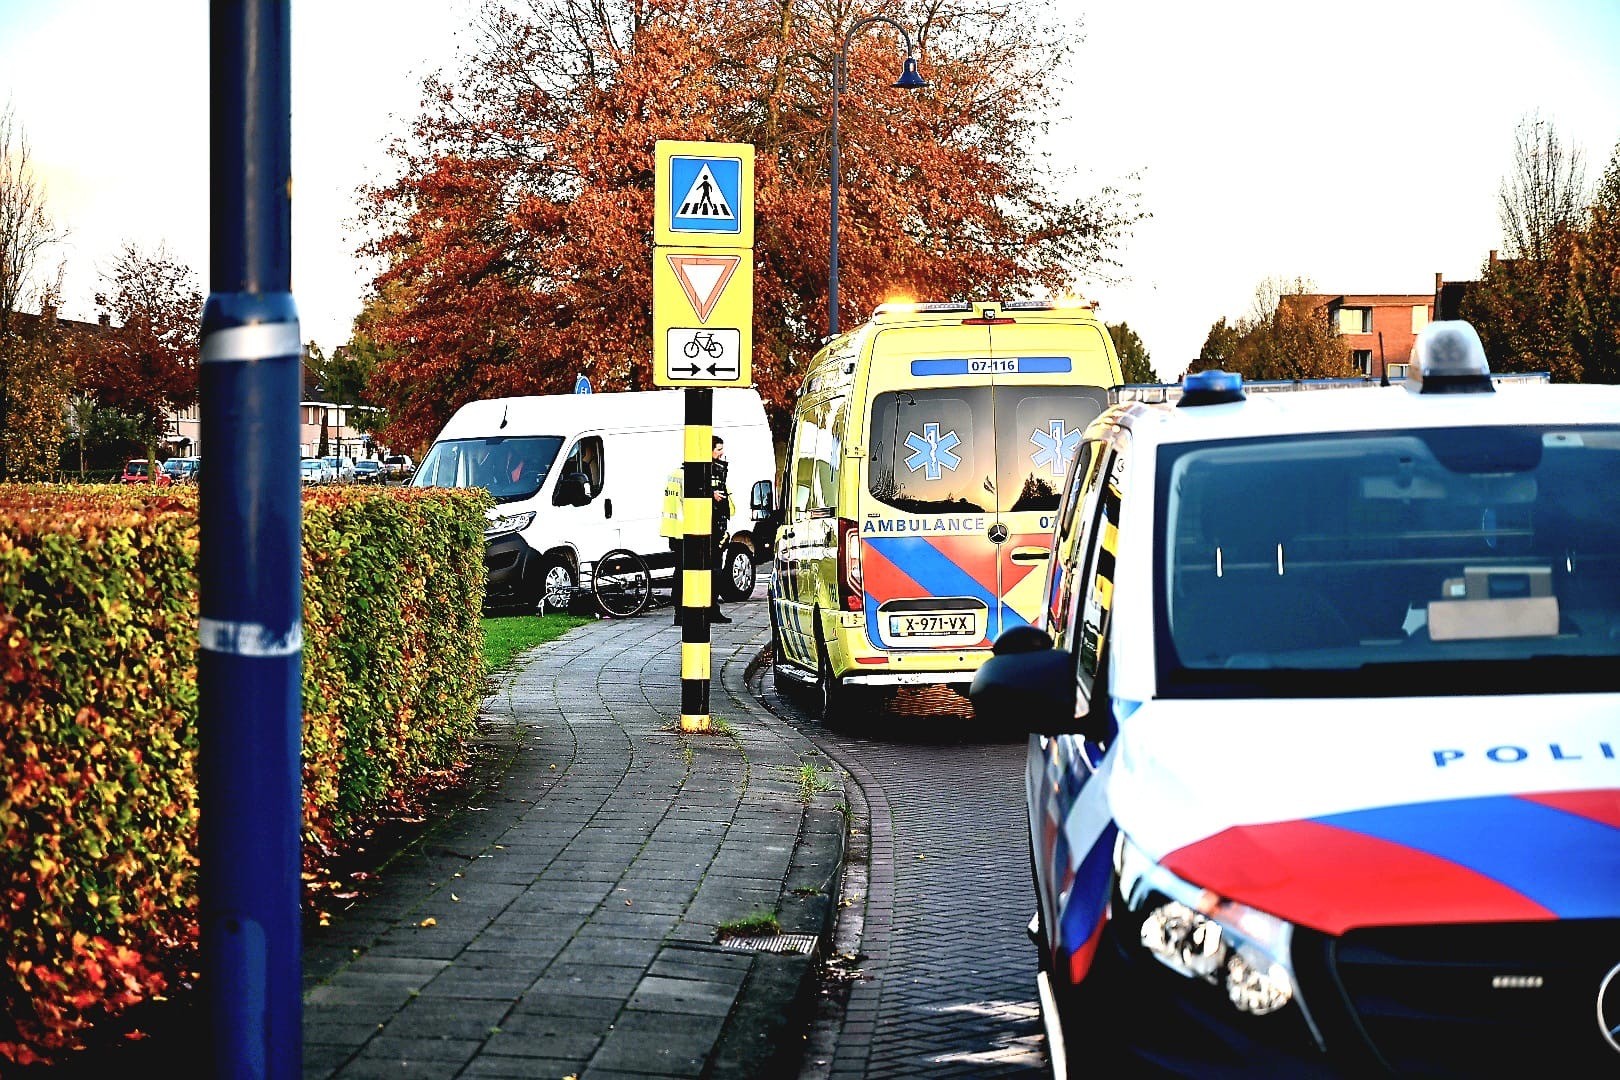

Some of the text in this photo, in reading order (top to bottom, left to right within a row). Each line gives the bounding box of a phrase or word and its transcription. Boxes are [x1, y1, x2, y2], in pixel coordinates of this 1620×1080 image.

[971, 360, 1015, 371] 07-116
[863, 517, 985, 533] AMBULANCE
[906, 616, 967, 631] X-971-VX
[1433, 741, 1615, 767] POLI
